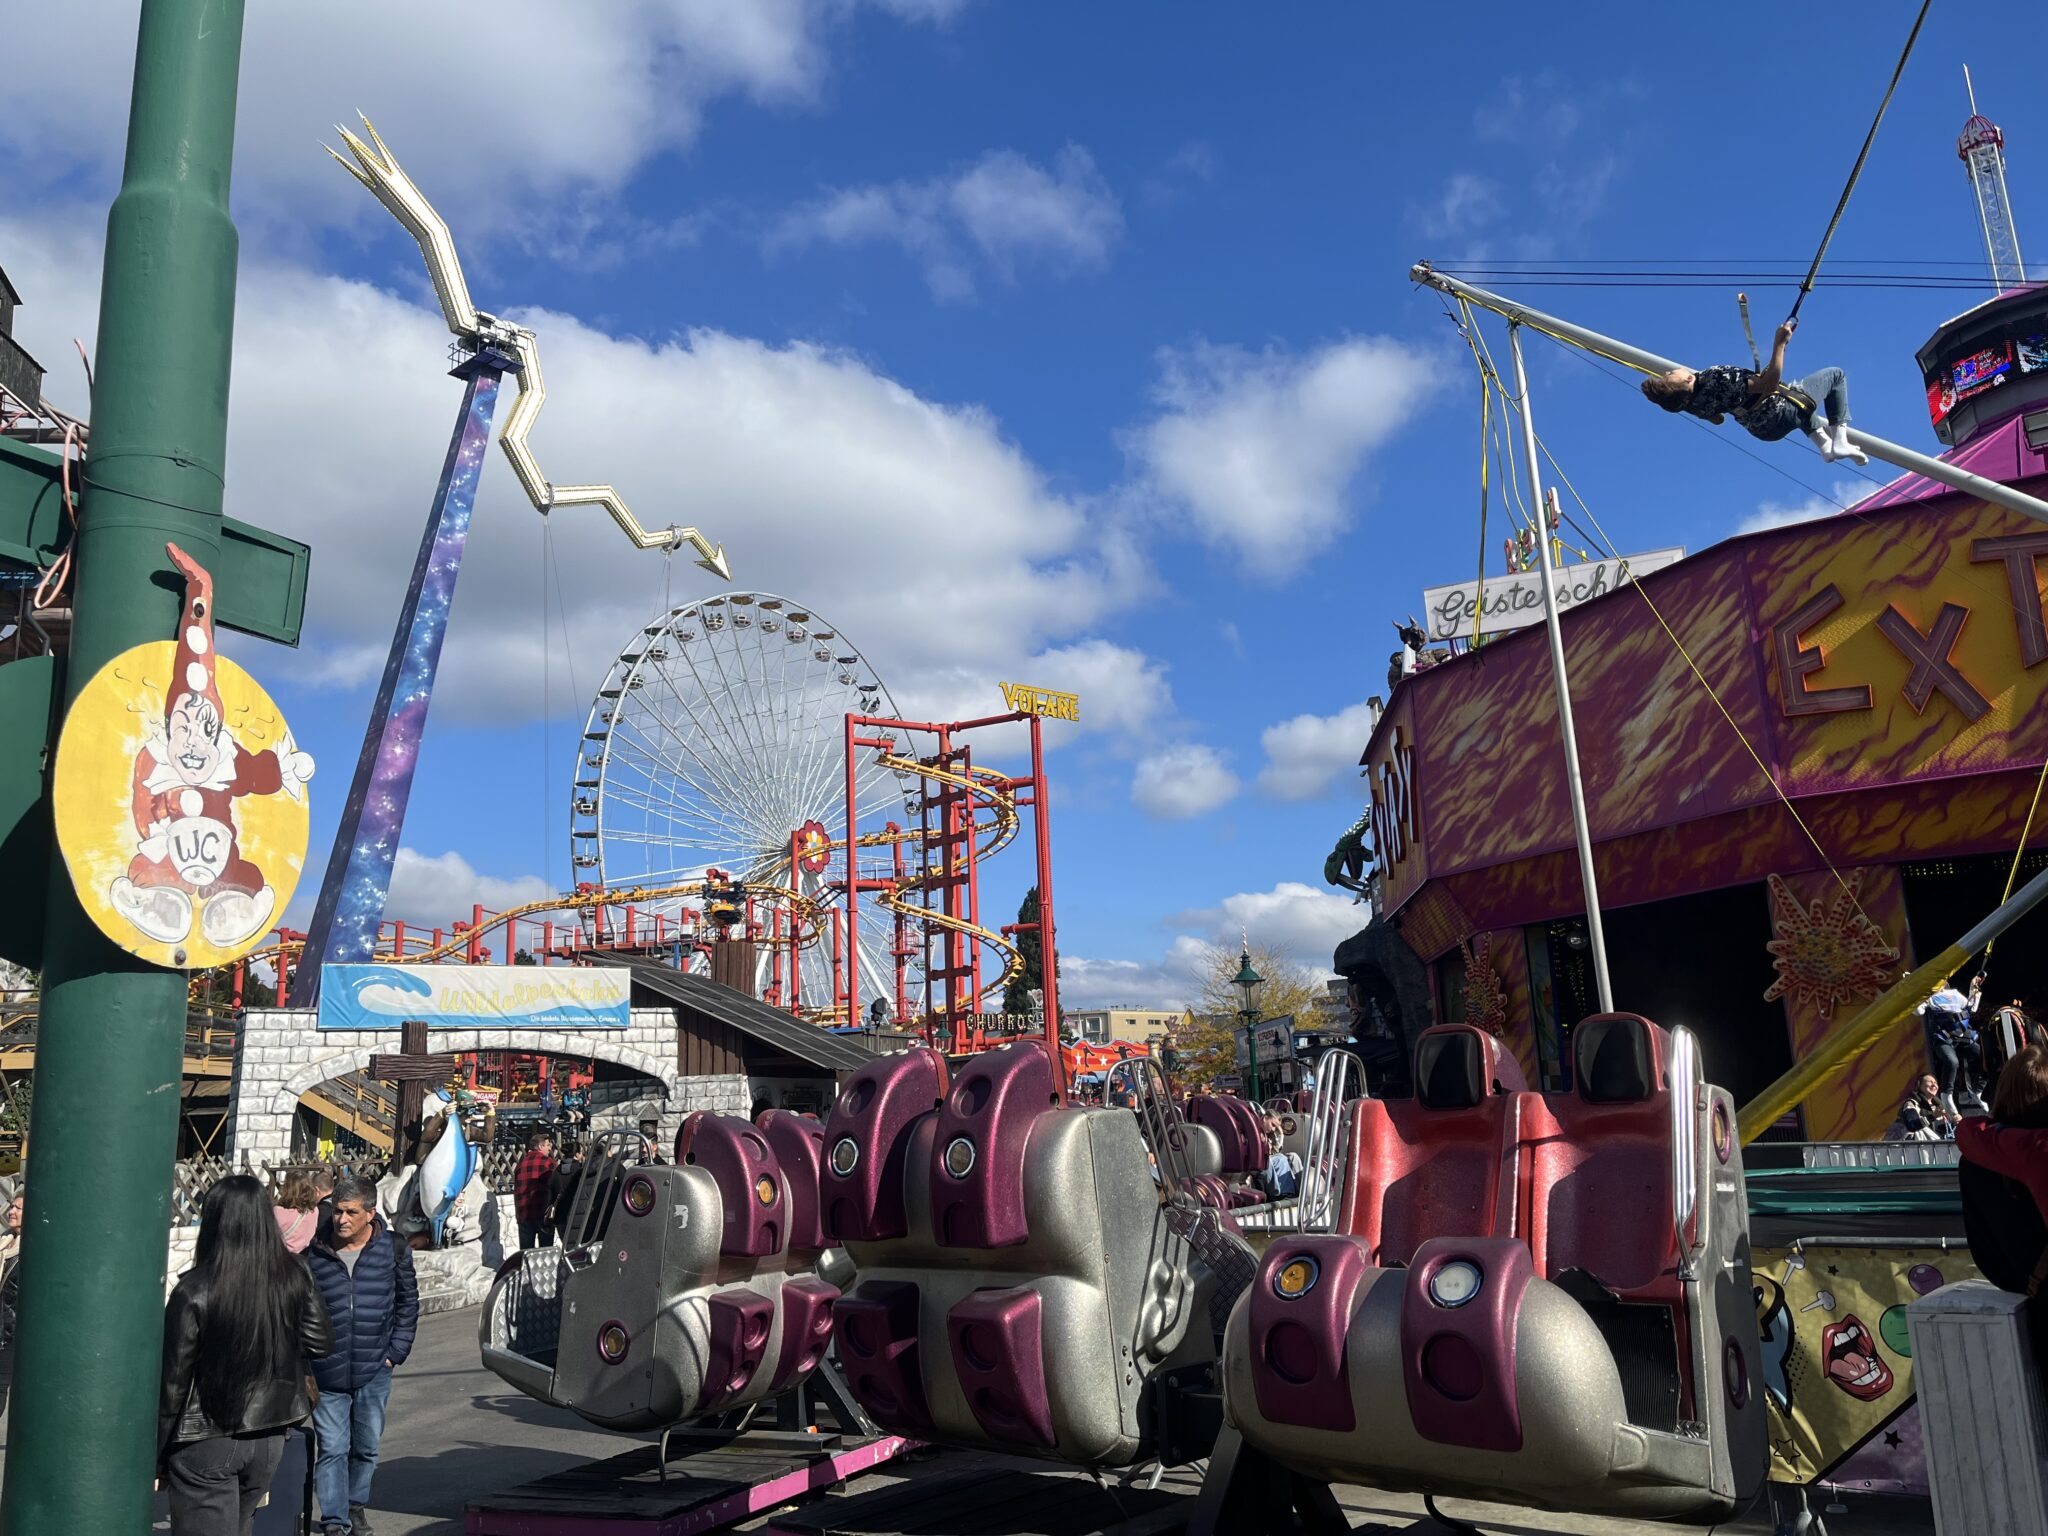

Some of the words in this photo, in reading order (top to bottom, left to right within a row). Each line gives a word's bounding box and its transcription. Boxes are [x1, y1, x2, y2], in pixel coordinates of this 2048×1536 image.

[1434, 560, 1643, 637] Geisteschl
[998, 681, 1079, 721] VOLARE
[174, 829, 220, 864] WC
[439, 979, 623, 1013] Wildalpenbahn
[966, 1013, 1035, 1030] CHURROS
